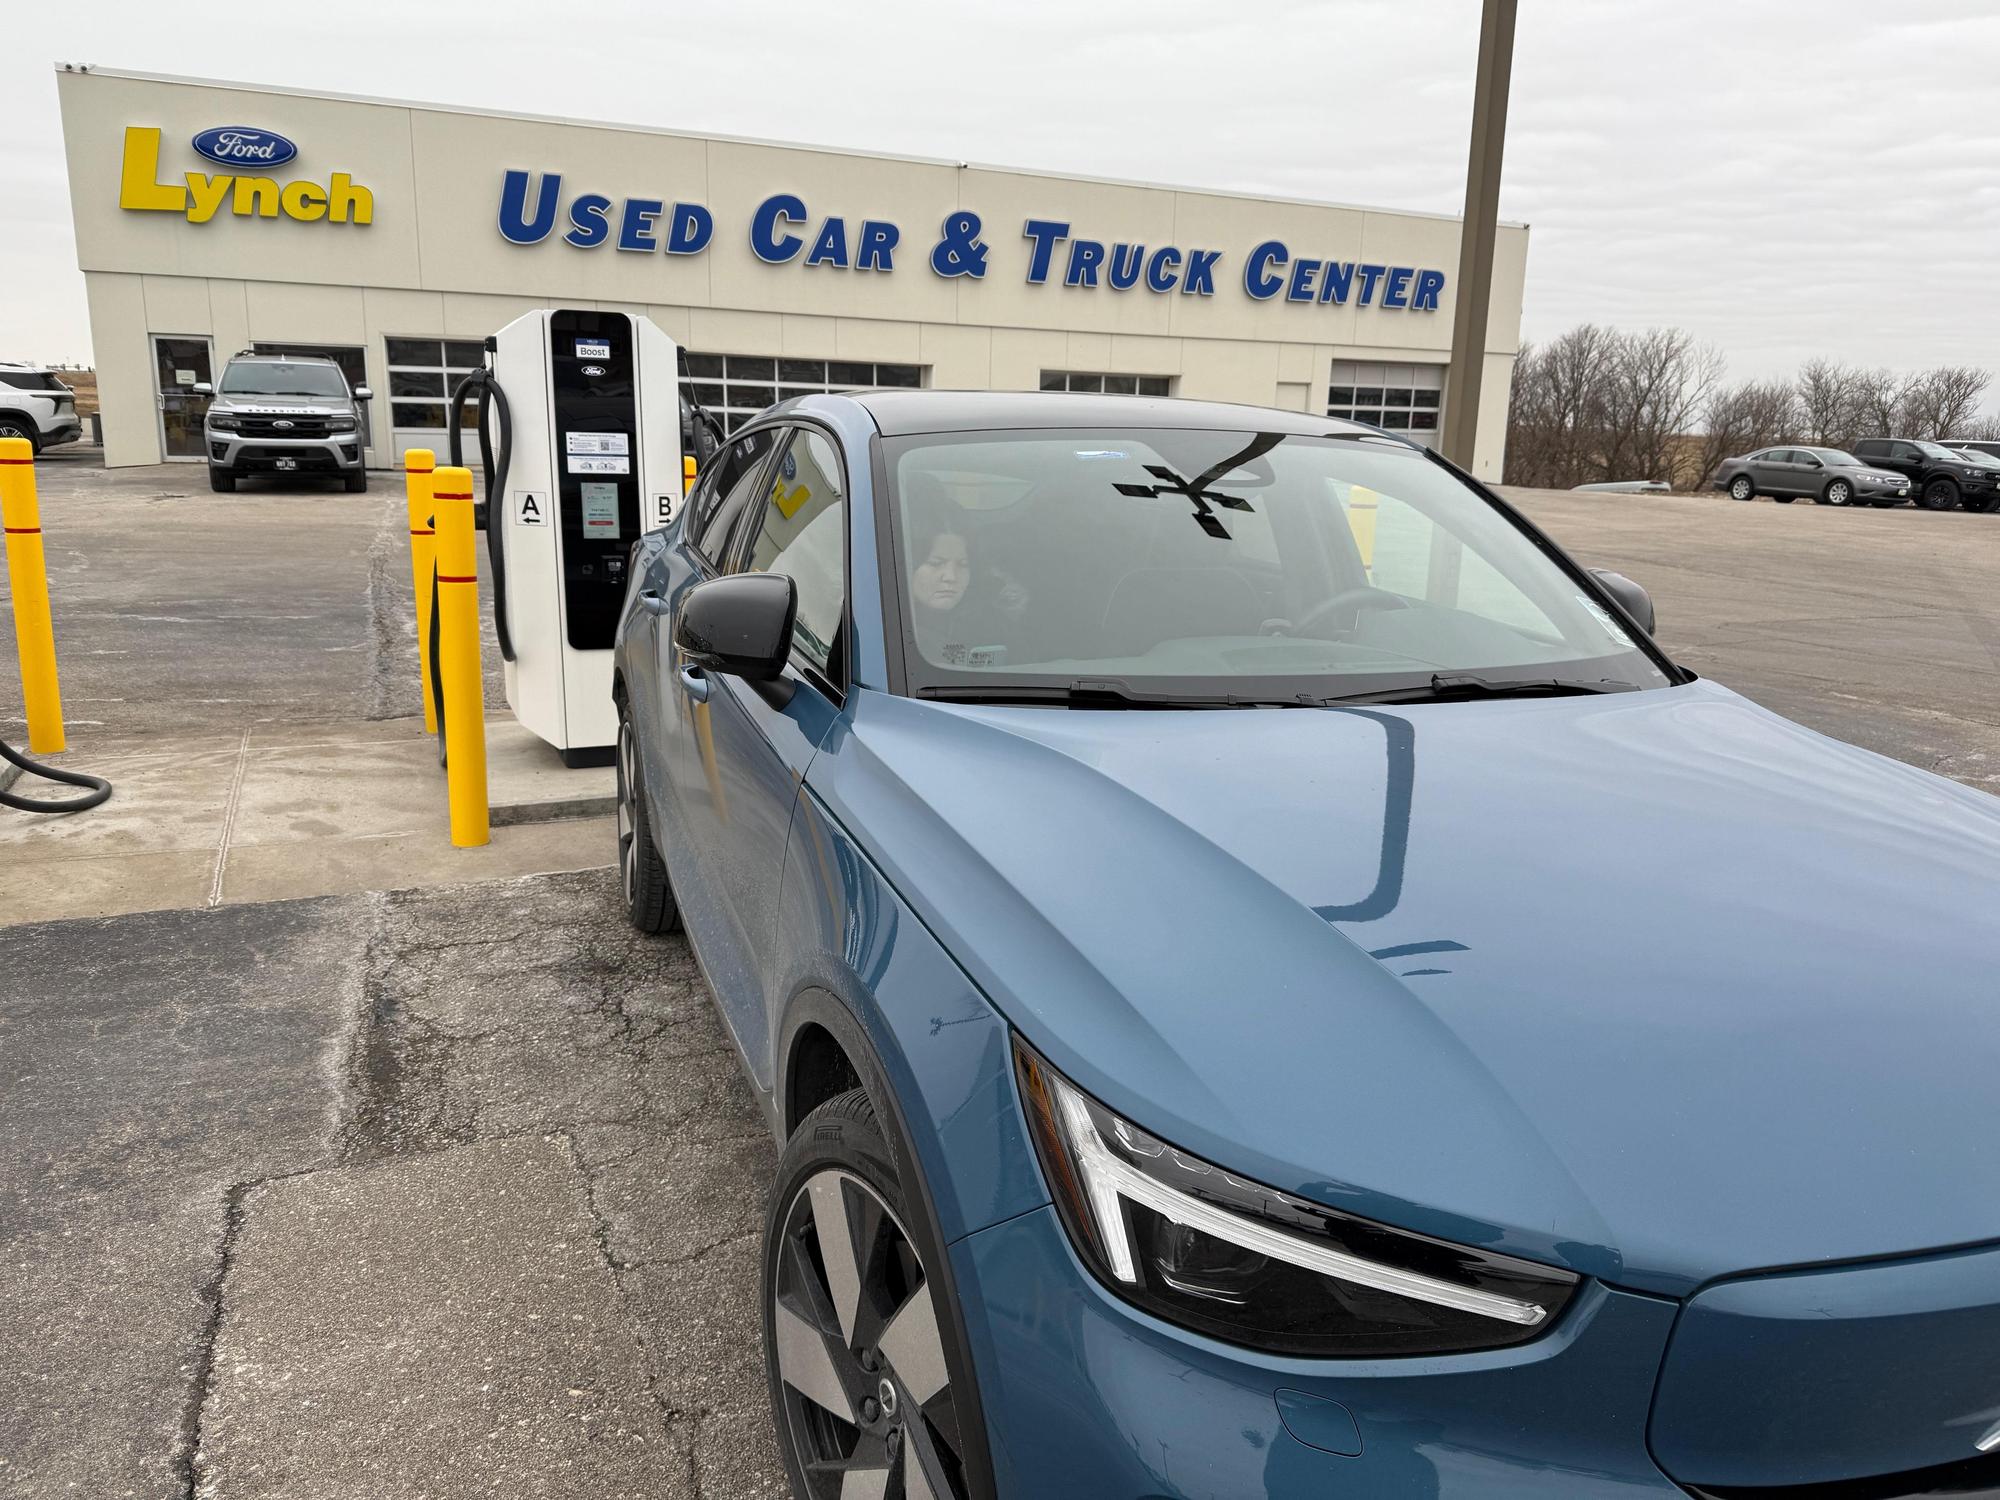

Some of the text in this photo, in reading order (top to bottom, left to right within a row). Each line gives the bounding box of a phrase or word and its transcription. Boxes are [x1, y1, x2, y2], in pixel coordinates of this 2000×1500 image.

[214, 132, 275, 159] Ford
[119, 126, 374, 224] Lynch
[497, 168, 1446, 311] USED CAR & TRUCK CENTER
[580, 347, 606, 357] Boost
[522, 494, 540, 515] A
[659, 496, 672, 516] B
